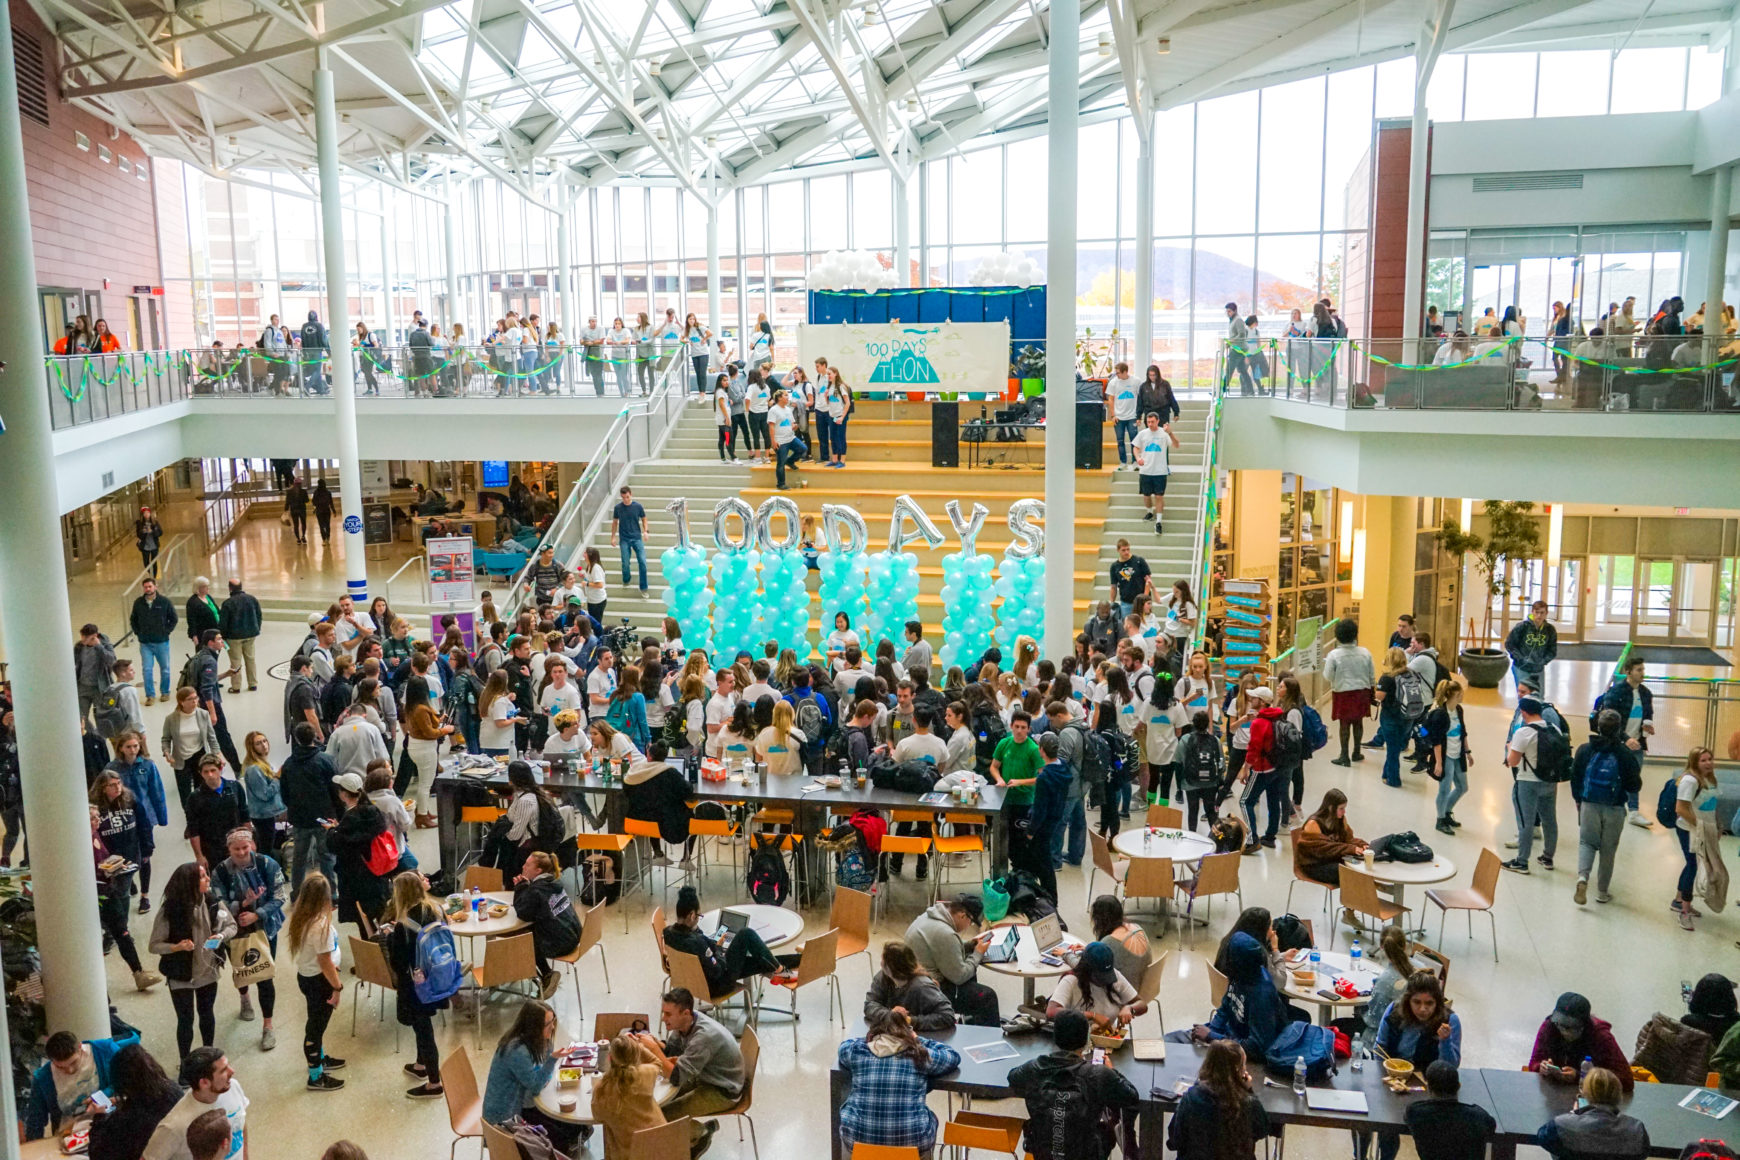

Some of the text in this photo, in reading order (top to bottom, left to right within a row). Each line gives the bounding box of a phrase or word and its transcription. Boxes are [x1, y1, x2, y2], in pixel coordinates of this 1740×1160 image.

[866, 338, 926, 356] 100 DAYS
[879, 357, 929, 381] THON
[665, 494, 1046, 559] 100 DAYS
[236, 961, 270, 977] FITNESS
